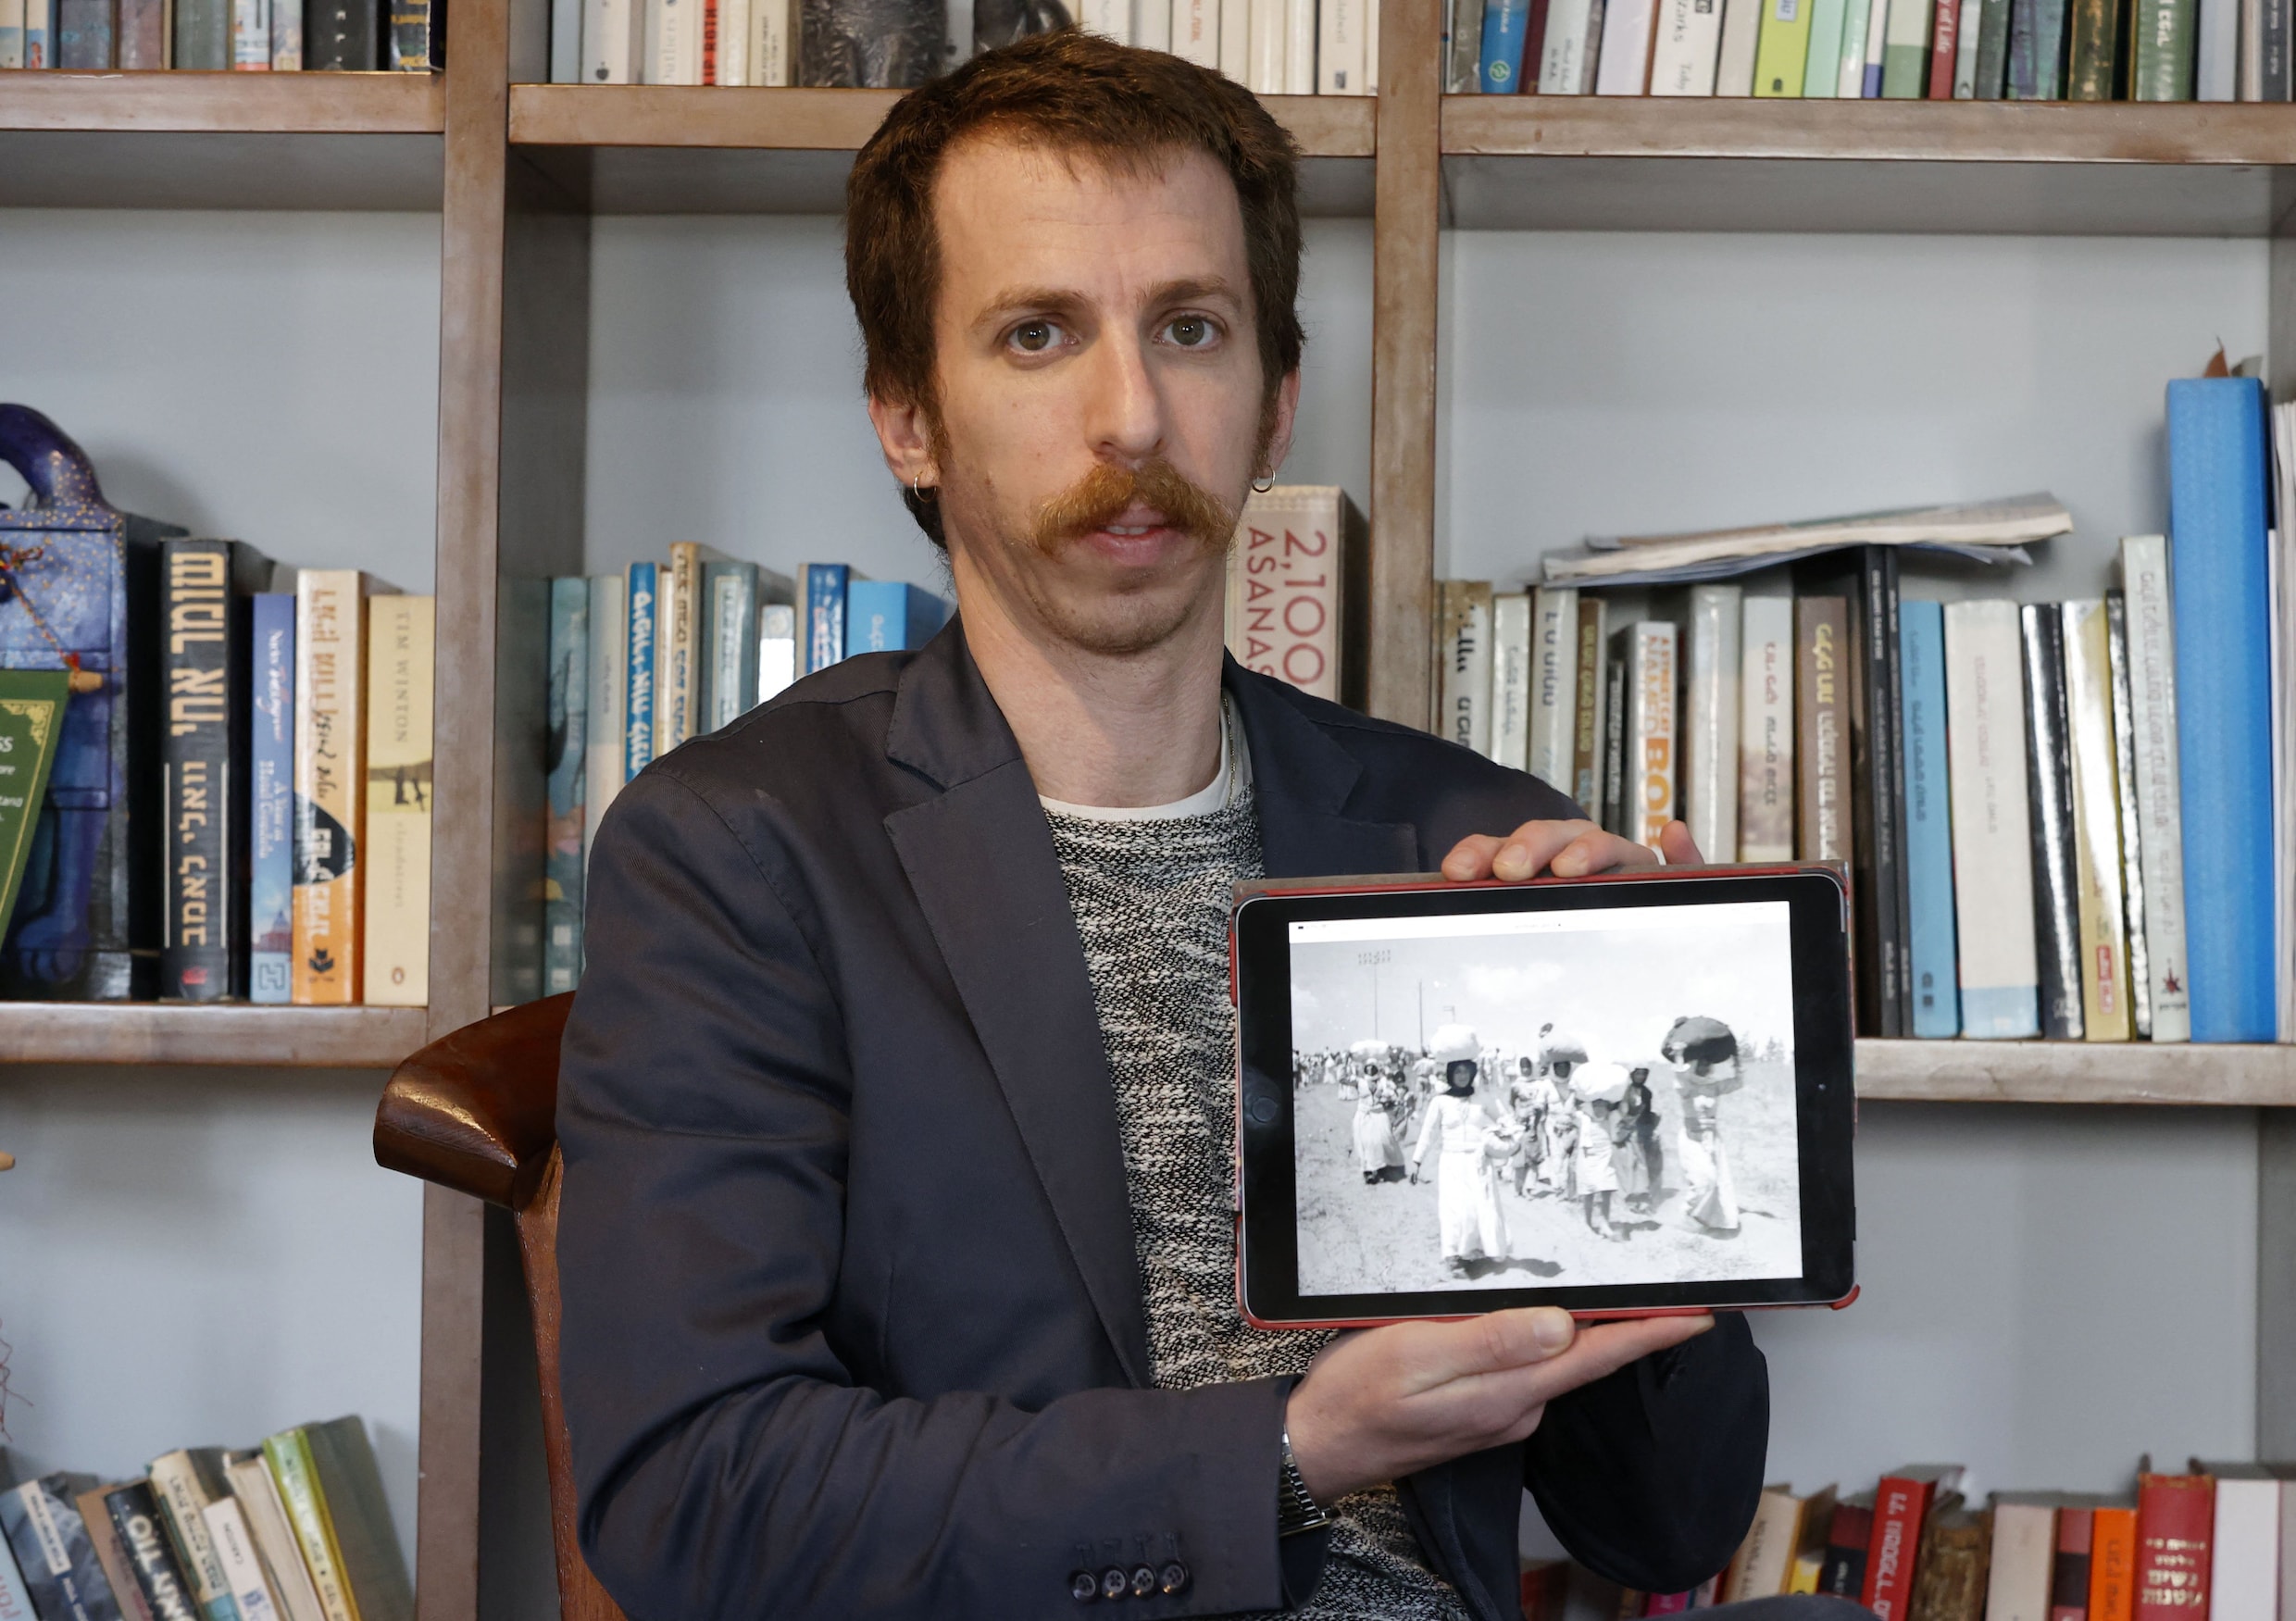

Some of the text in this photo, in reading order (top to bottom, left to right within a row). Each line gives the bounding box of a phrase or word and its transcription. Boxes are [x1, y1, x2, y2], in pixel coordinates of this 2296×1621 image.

[169, 551, 226, 738] שומר אחי
[395, 612, 409, 743] TIM WINTON
[626, 591, 654, 771] סיפורי אוה לונה
[1279, 528, 1328, 686] 2,100
[181, 760, 207, 947] וואלי לאמב
